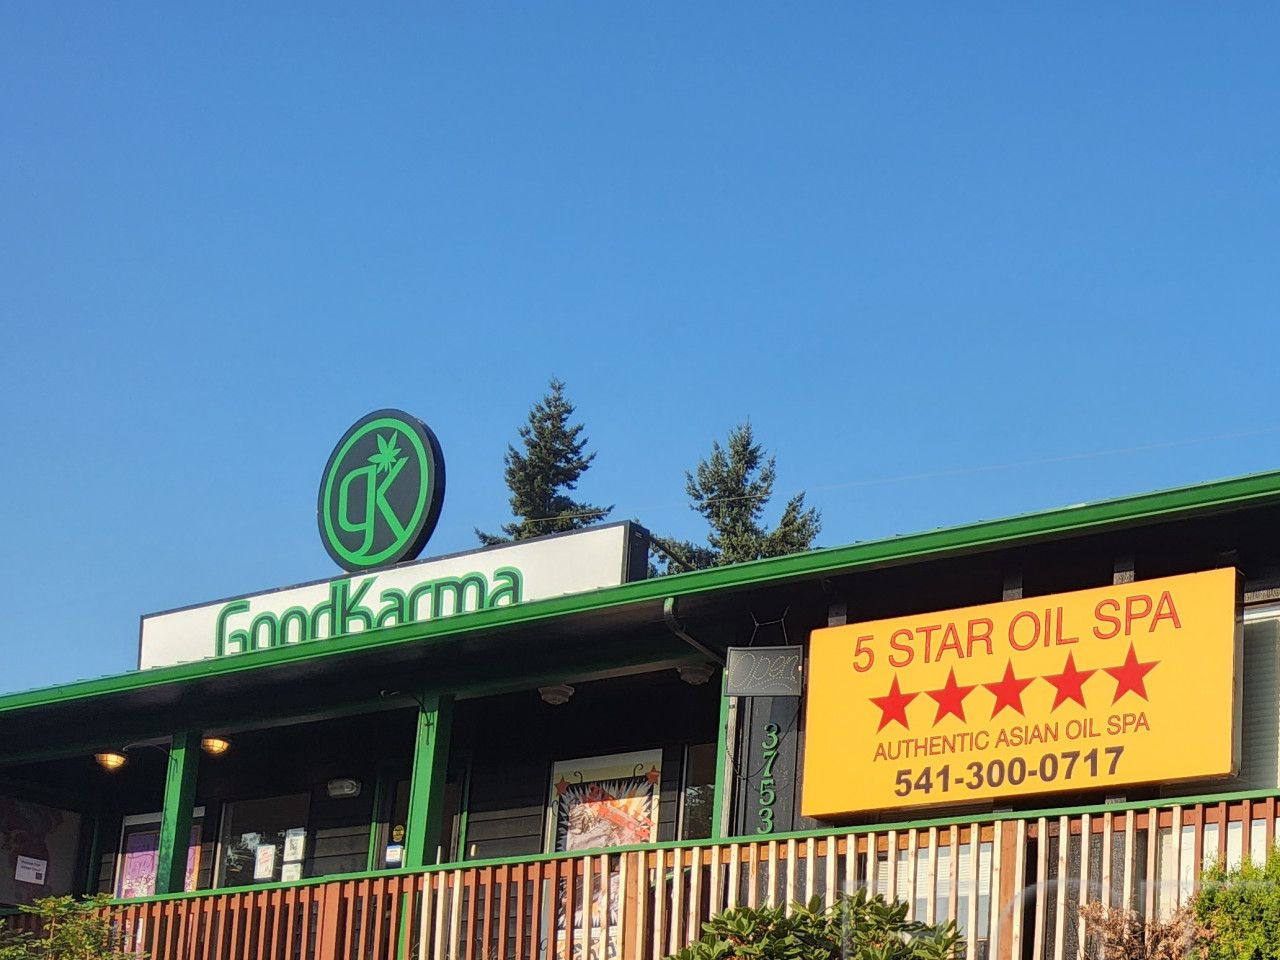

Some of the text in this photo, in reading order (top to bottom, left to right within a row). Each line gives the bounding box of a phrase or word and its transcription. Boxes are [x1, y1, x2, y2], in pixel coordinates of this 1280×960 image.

[853, 590, 1182, 673] 5 STAR OIL SPA
[873, 711, 1151, 762] AUTHENTIC ASIAN OIL SPA
[757, 723, 779, 834] 3753
[894, 746, 1125, 797] 541-300-0717
